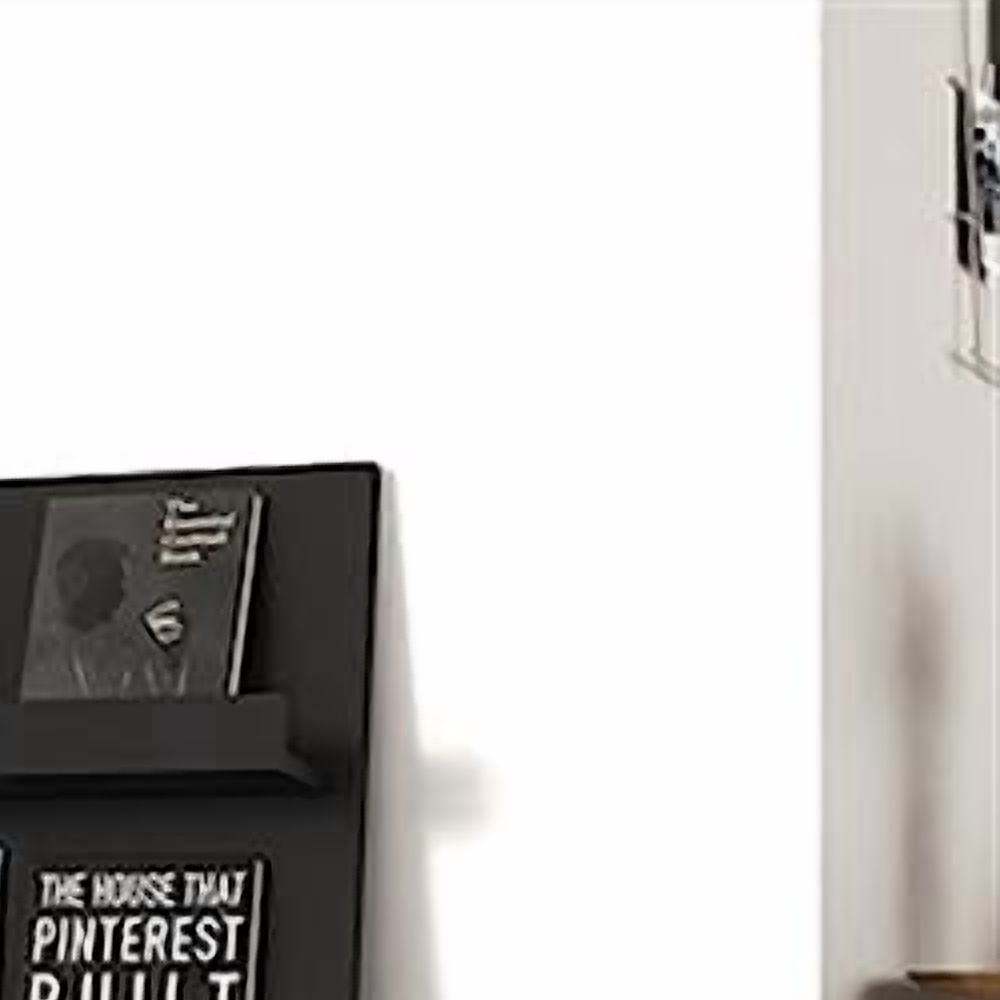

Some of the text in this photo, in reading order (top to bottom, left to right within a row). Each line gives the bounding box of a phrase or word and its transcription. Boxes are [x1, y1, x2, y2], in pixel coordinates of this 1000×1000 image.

[41, 870, 248, 907] THE HOUSE THAT
[32, 914, 244, 963] PINTEREST
